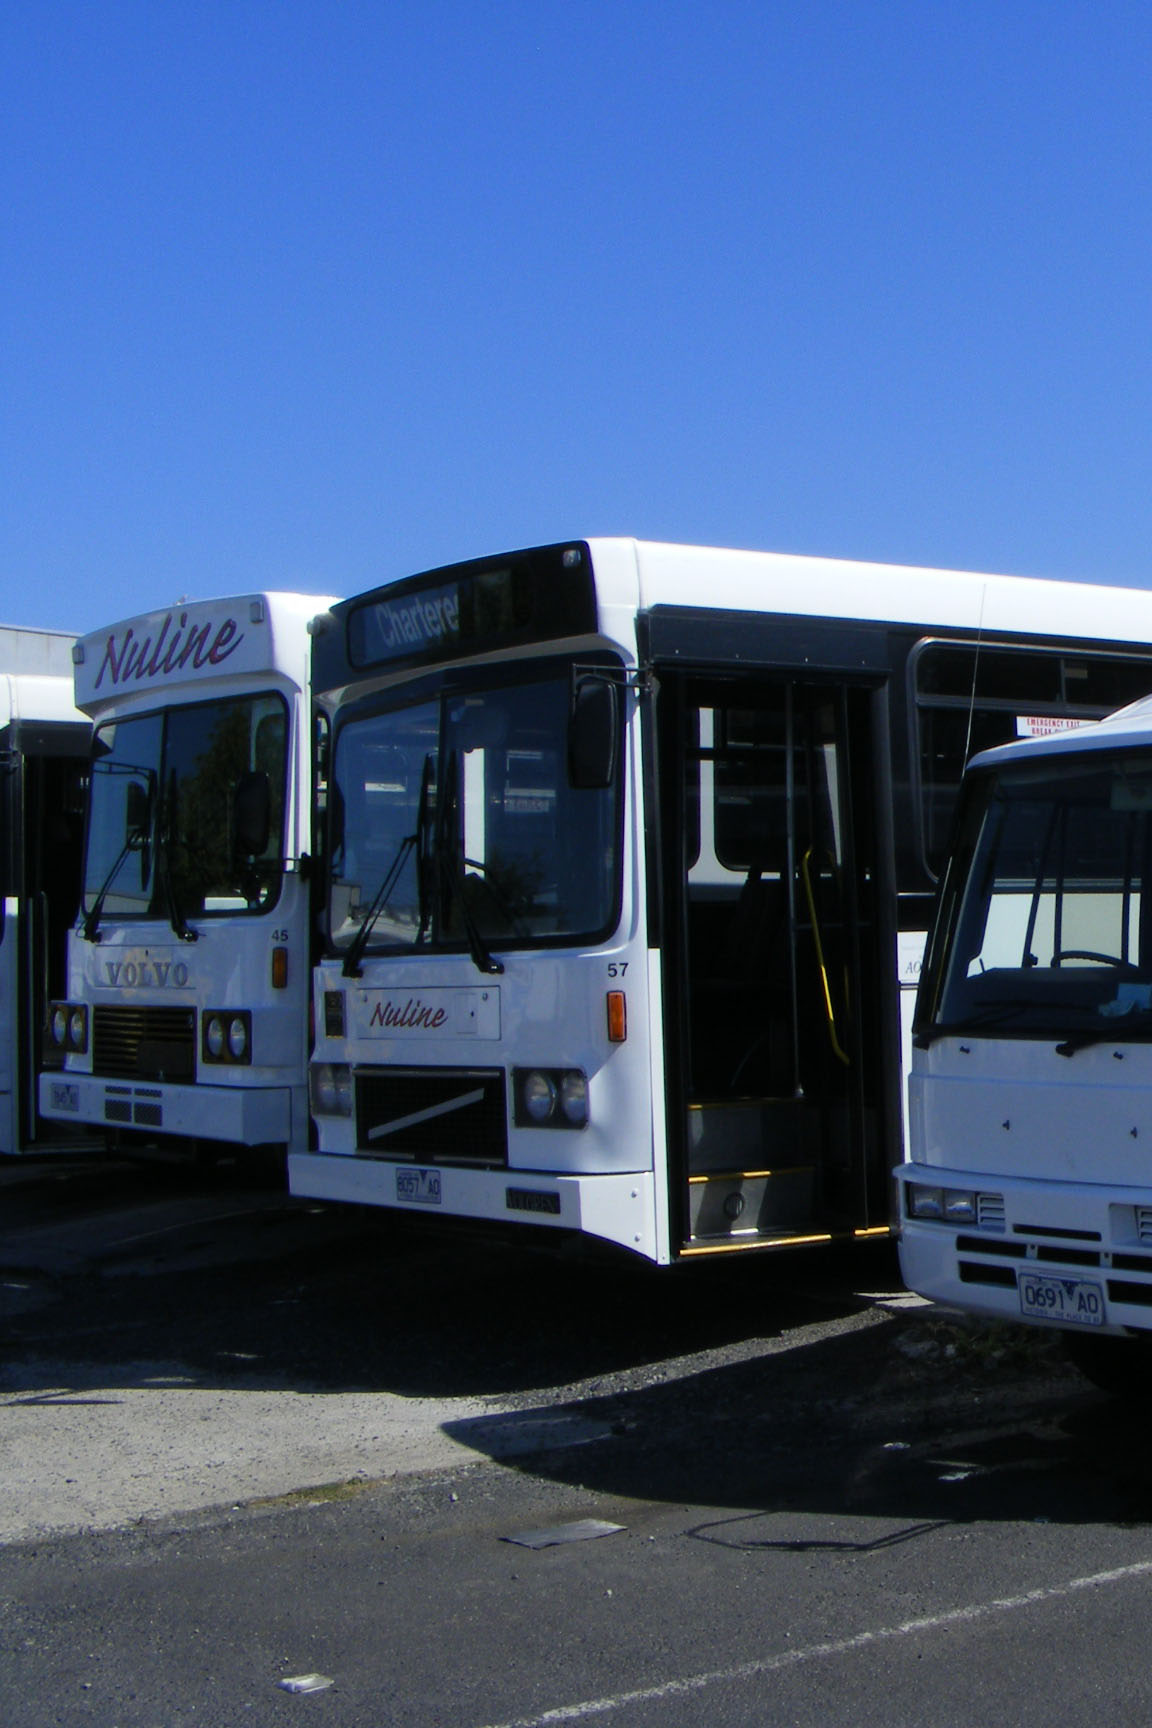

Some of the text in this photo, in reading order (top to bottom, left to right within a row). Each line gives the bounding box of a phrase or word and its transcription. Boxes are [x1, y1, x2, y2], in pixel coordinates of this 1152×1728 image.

[95, 612, 245, 689] Nuline
[1027, 718, 1080, 728] EMERGENCY EXIT
[271, 929, 289, 942] 45
[105, 961, 188, 987] VOLVO
[607, 962, 629, 978] 57
[370, 999, 448, 1028] Nuline
[1025, 1284, 1065, 1310] 0691
[1078, 1291, 1099, 1314] AO
